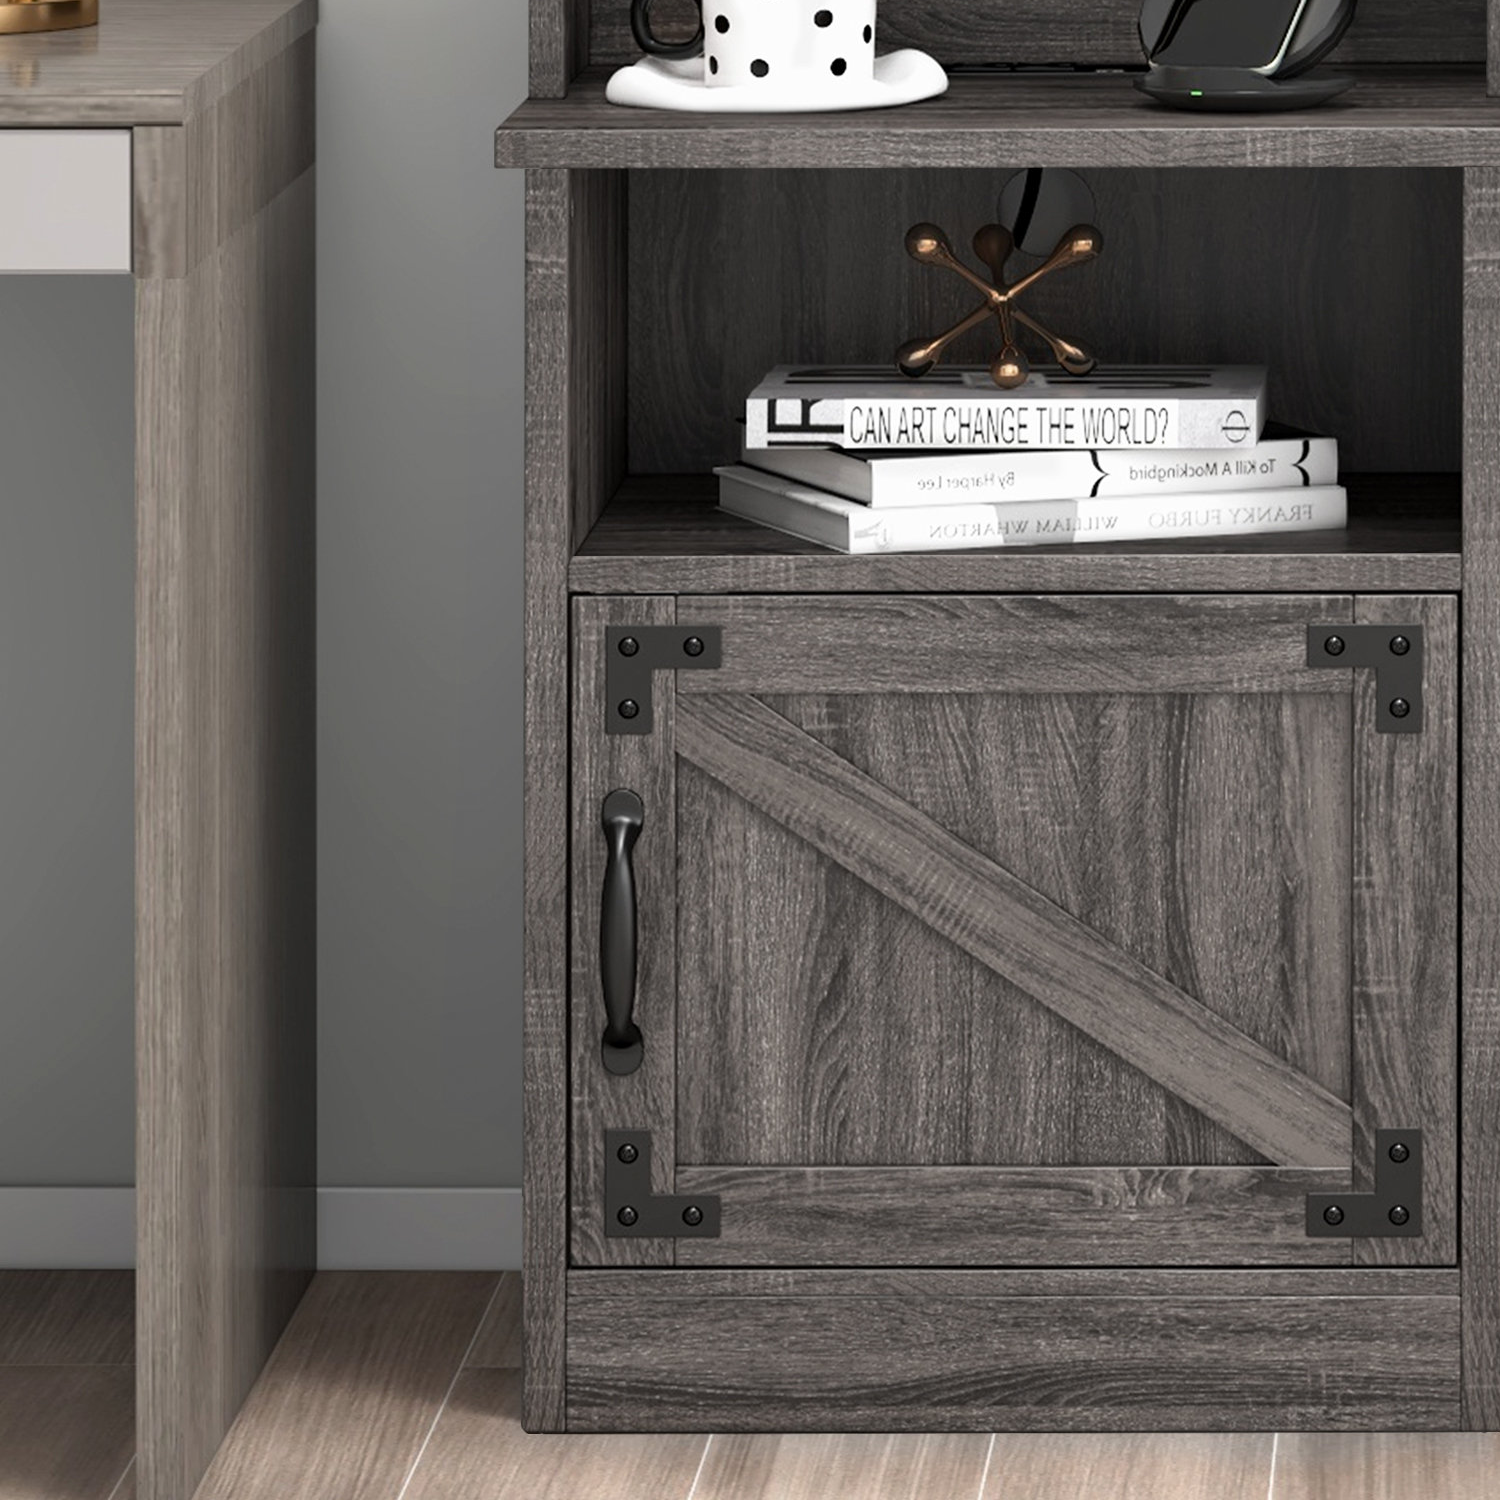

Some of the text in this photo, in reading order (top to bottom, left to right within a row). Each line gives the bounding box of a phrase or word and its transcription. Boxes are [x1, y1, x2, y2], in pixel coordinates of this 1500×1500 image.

[850, 406, 892, 444] CAN
[896, 406, 937, 444] ART
[943, 406, 1029, 444] CHANGE
[1036, 407, 1075, 444] THE
[1082, 407, 1169, 444] WORLD?
